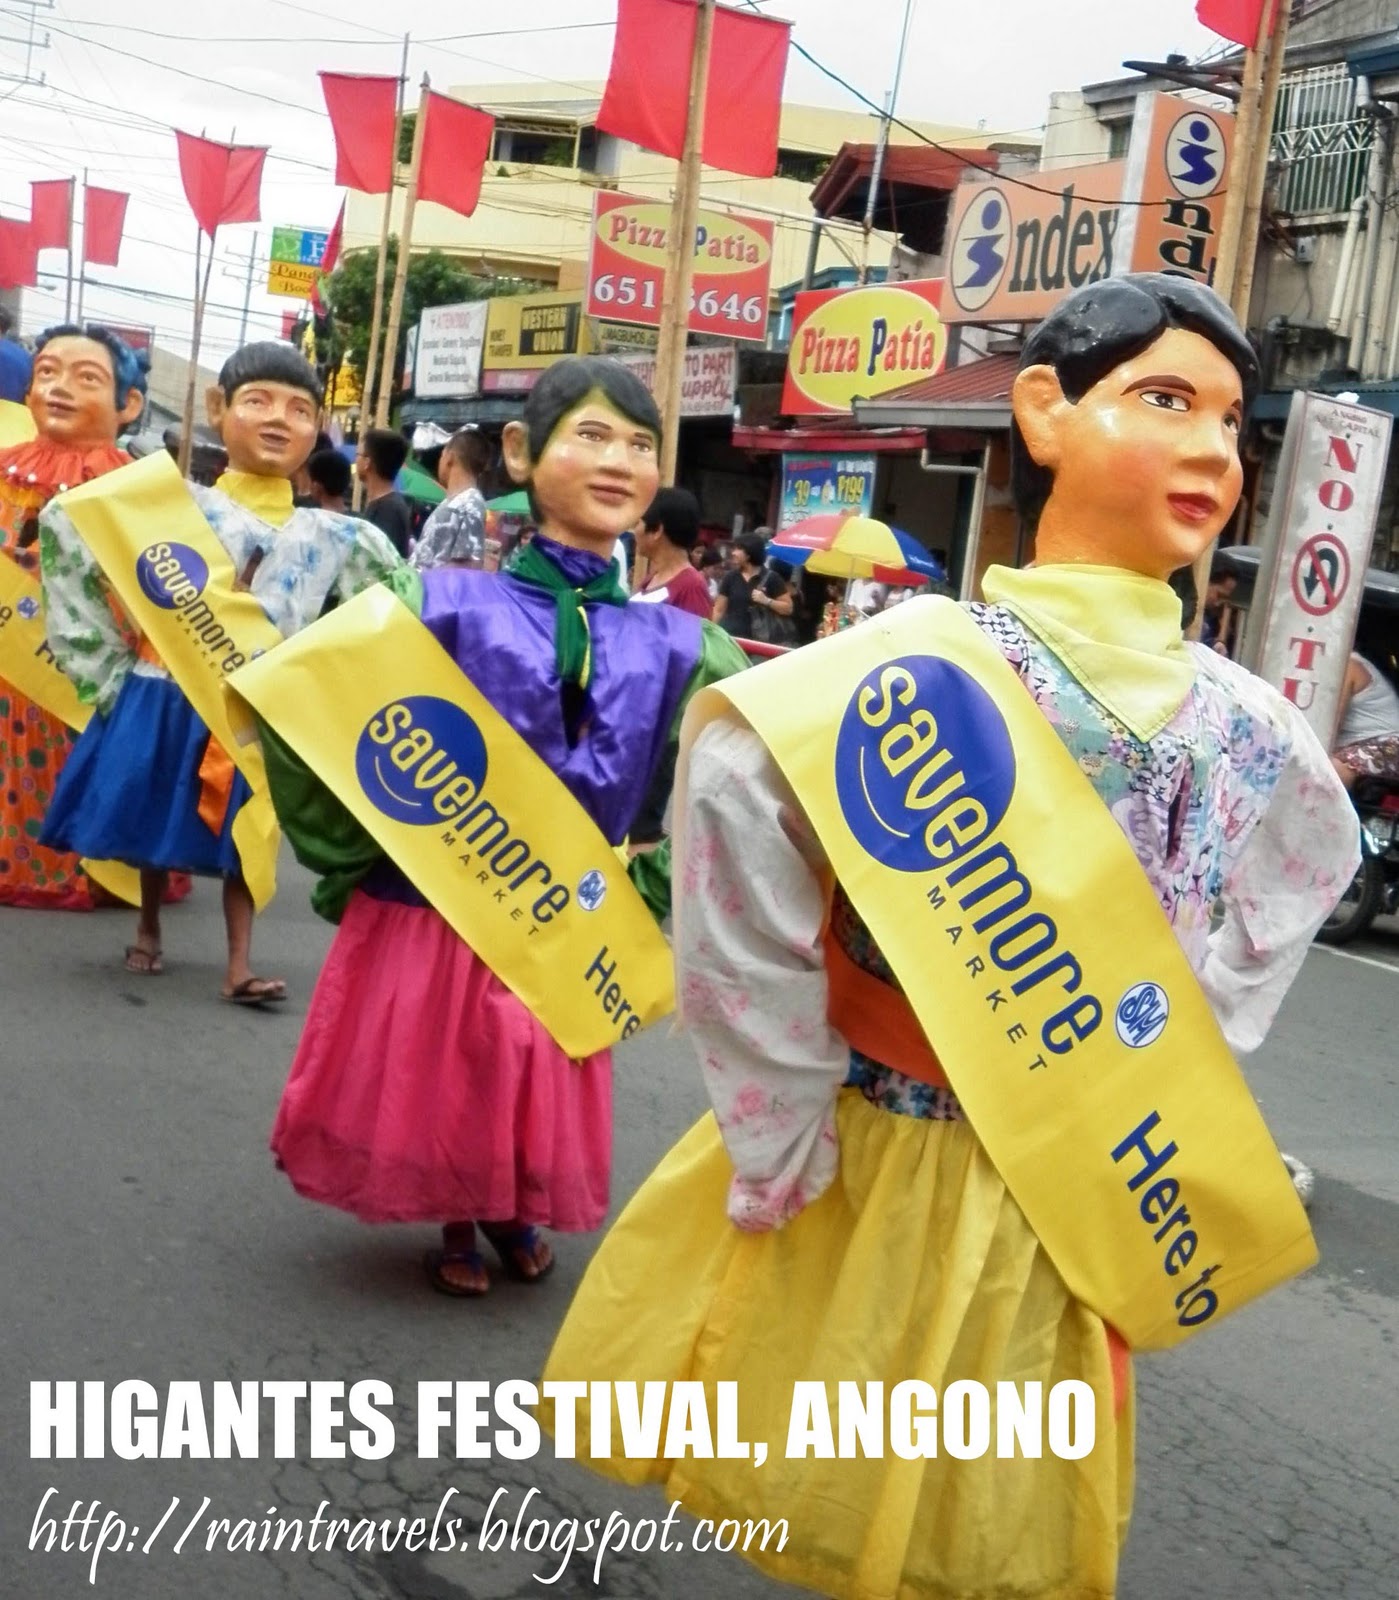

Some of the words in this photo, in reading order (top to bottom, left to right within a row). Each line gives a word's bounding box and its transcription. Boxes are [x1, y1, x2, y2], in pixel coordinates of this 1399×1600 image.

[608, 214, 667, 249] Pizz
[522, 306, 568, 330] WESTERN
[594, 274, 656, 309] 651
[533, 330, 565, 352] UNION
[685, 354, 700, 377] TO
[799, 327, 860, 375] Pizza
[867, 318, 936, 376] Patia
[681, 375, 732, 401] upply
[1319, 435, 1363, 511] NO
[146, 543, 245, 673] savemore
[1283, 637, 1326, 710] TU
[369, 704, 570, 923] savemore
[440, 831, 539, 936] MARKET
[858, 666, 1103, 1055] savemore
[585, 946, 641, 1040] Here
[926, 885, 1047, 1072] MARKET
[1110, 1110, 1198, 1277] Here
[1175, 1264, 1223, 1327] to
